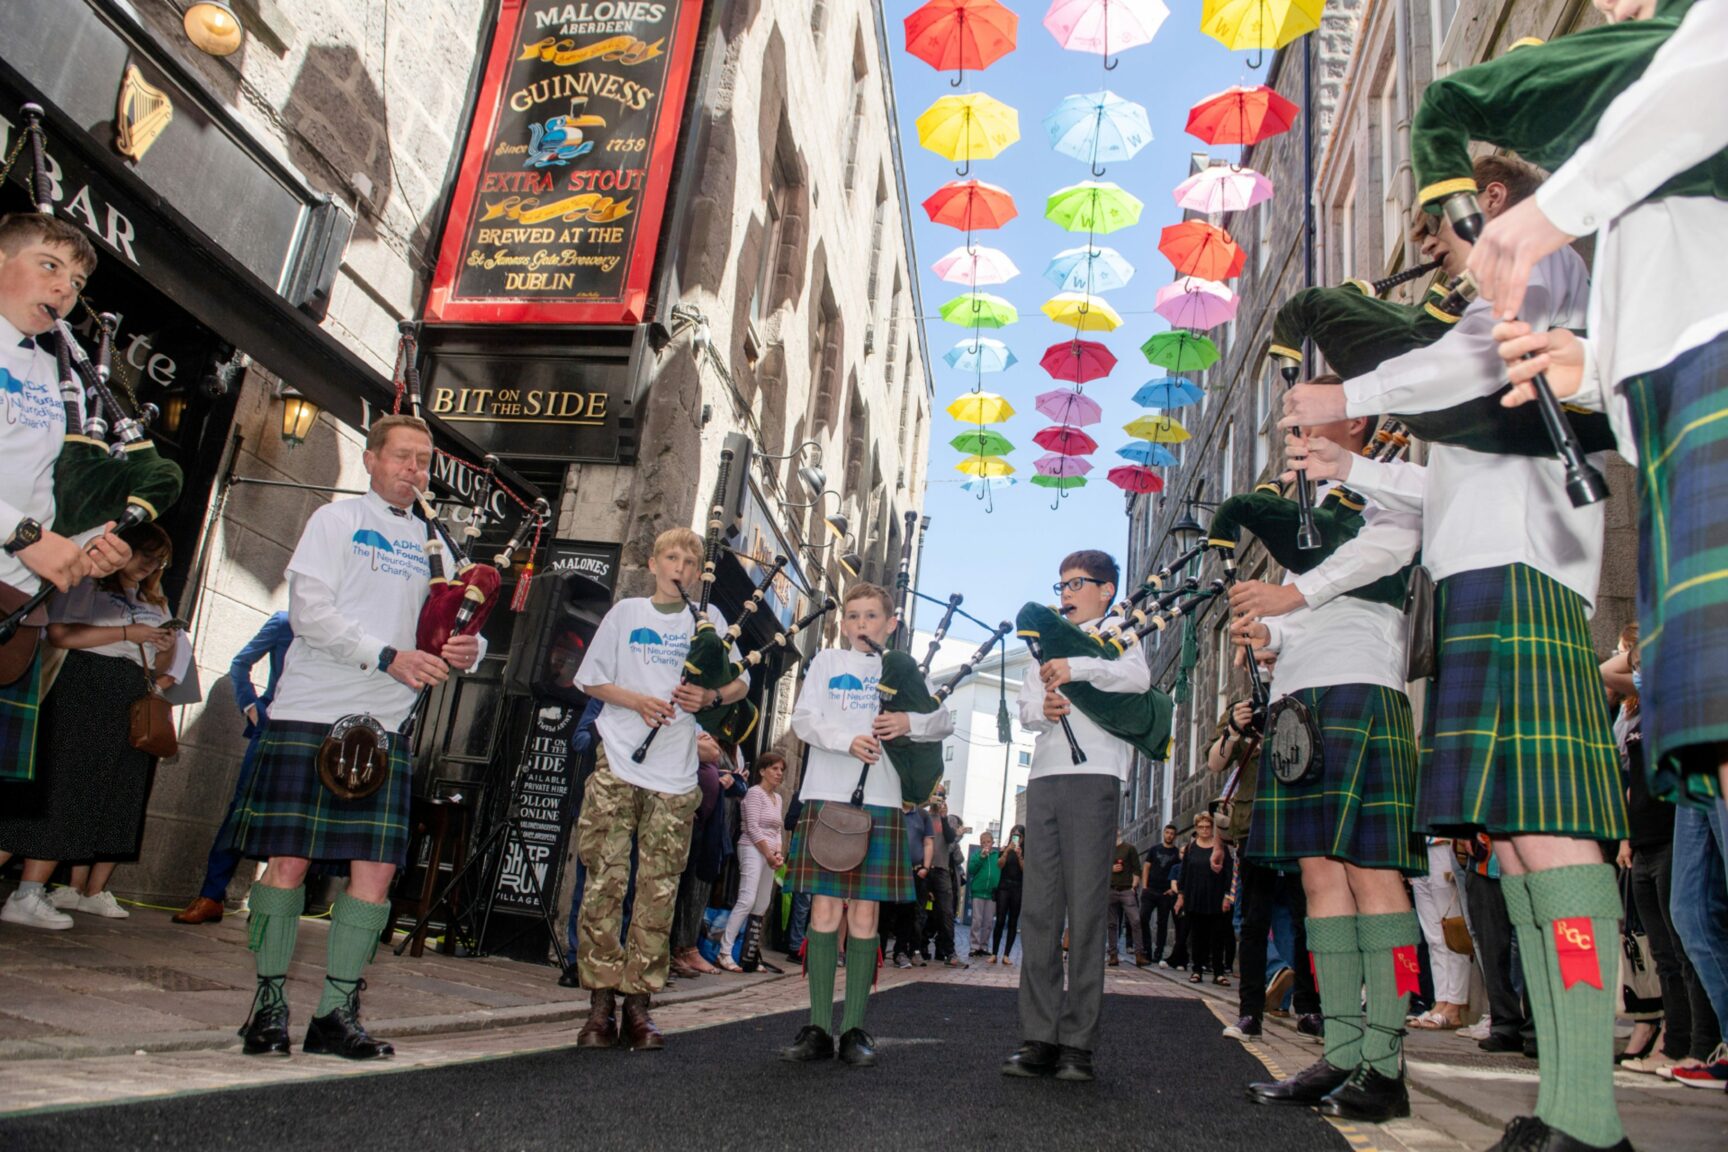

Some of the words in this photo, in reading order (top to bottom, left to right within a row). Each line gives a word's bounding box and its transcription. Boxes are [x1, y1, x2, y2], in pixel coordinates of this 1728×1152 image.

[535, 1, 666, 28] MALONES
[560, 21, 634, 35] ABERDEEN
[510, 71, 655, 112] GUINNESS
[606, 138, 647, 152] 1759
[480, 171, 554, 195] EXTRA
[567, 168, 645, 192] STOUT
[478, 228, 556, 247] BREWED
[558, 228, 584, 243] AT
[587, 227, 624, 243] THE
[558, 249, 621, 273] Brewery
[505, 272, 576, 290] DUBLIN
[432, 388, 494, 414] BIT
[498, 389, 521, 401] ON
[491, 403, 522, 416] THE
[523, 390, 609, 418] SIDE
[352, 545, 370, 557] The
[380, 563, 412, 581] Charity
[552, 557, 610, 576] MALONES
[652, 656, 679, 667] Charity
[850, 701, 878, 711] Charity
[554, 739, 568, 748] ON
[527, 773, 567, 785] AILABLE
[523, 781, 551, 794] PRIVATE
[551, 784, 569, 794] HIRE
[520, 794, 561, 809] OLLOW
[520, 807, 561, 821] ONLINE
[1557, 920, 1592, 950] RGC
[1397, 952, 1418, 973] RGC
